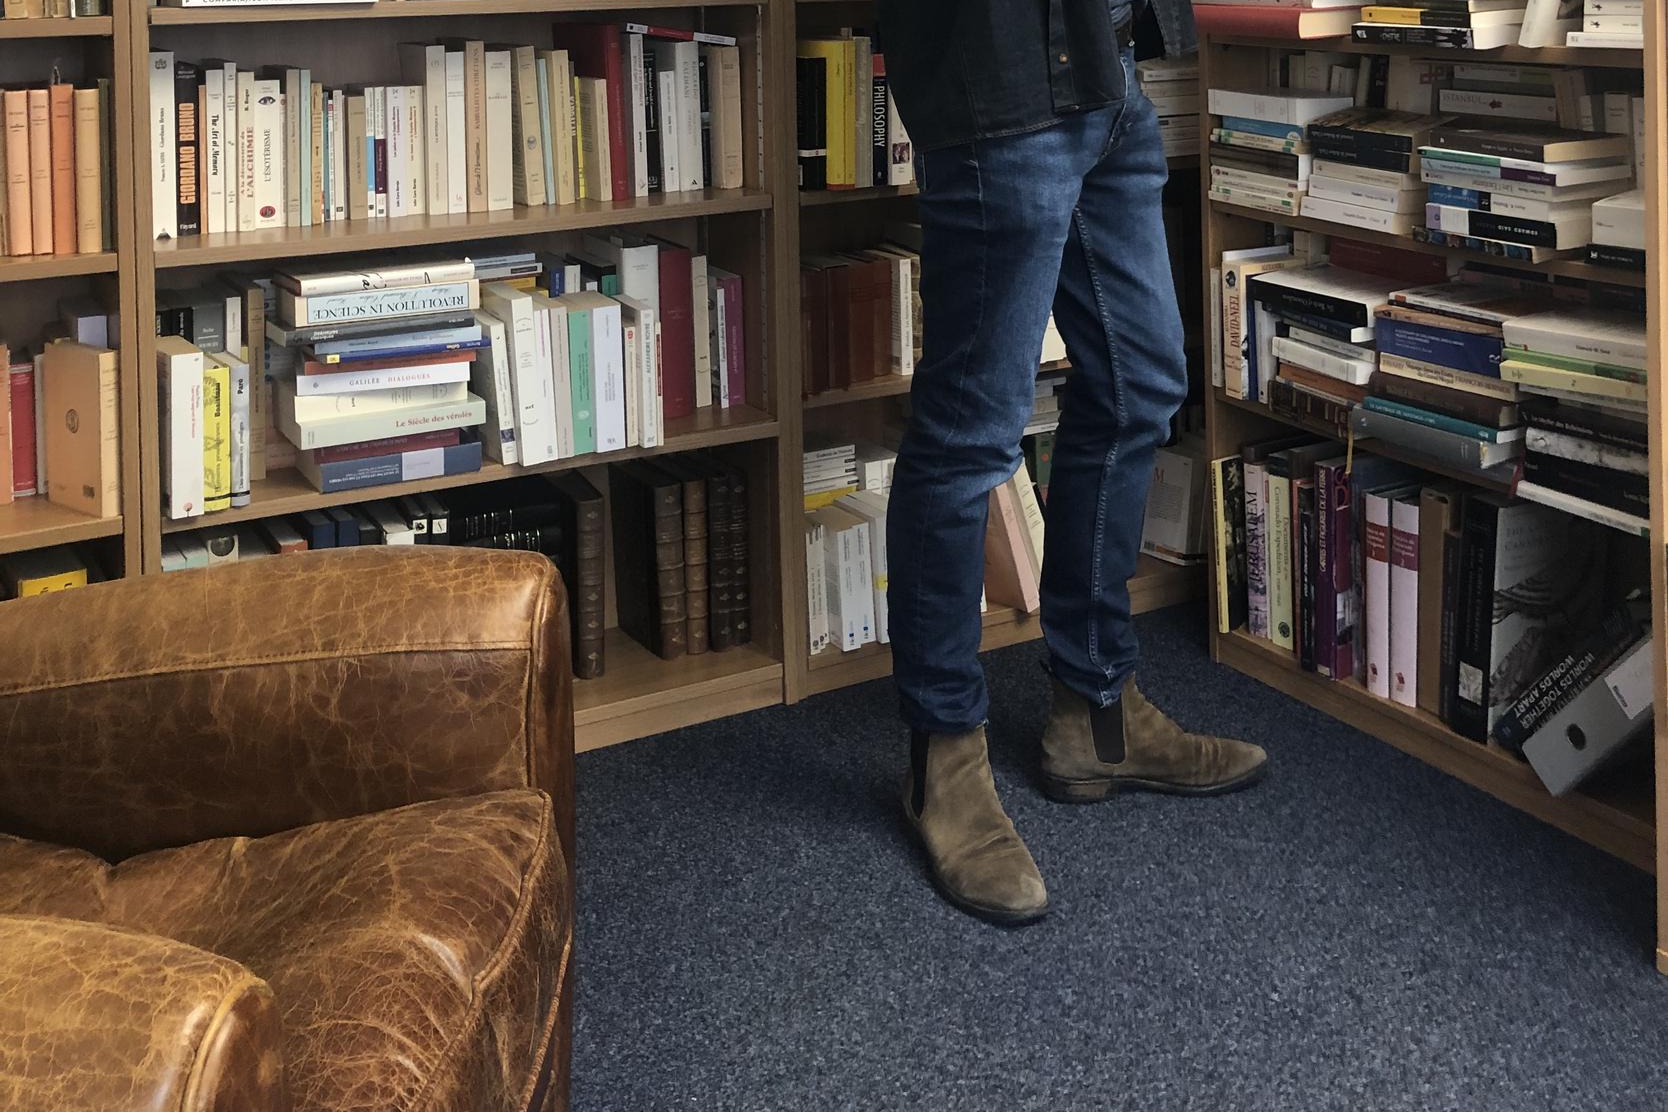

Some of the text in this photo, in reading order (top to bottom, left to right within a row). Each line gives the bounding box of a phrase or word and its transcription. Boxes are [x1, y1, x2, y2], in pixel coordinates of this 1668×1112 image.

[211, 115, 220, 126] The
[873, 85, 886, 147] PHILOSOPHY
[211, 127, 220, 139] Art
[179, 103, 196, 204] GIORDANO BRUNO
[211, 148, 220, 176] Memory
[246, 126, 254, 198] L'ALCHIMIE
[1497, 224, 1539, 236] EDWARD SAID
[314, 295, 464, 320] REVOLUTION IN SCIENCE
[387, 373, 431, 383] DIALOGUES
[395, 411, 473, 429] Le Siècle des vérolés
[1274, 486, 1283, 529] Coronado
[1245, 491, 1263, 584] JERUSALEM
[1318, 549, 1327, 573] CARTES
[1513, 654, 1575, 718] WORLDS APART
[1519, 651, 1596, 729] WORLDS TOGETHER
